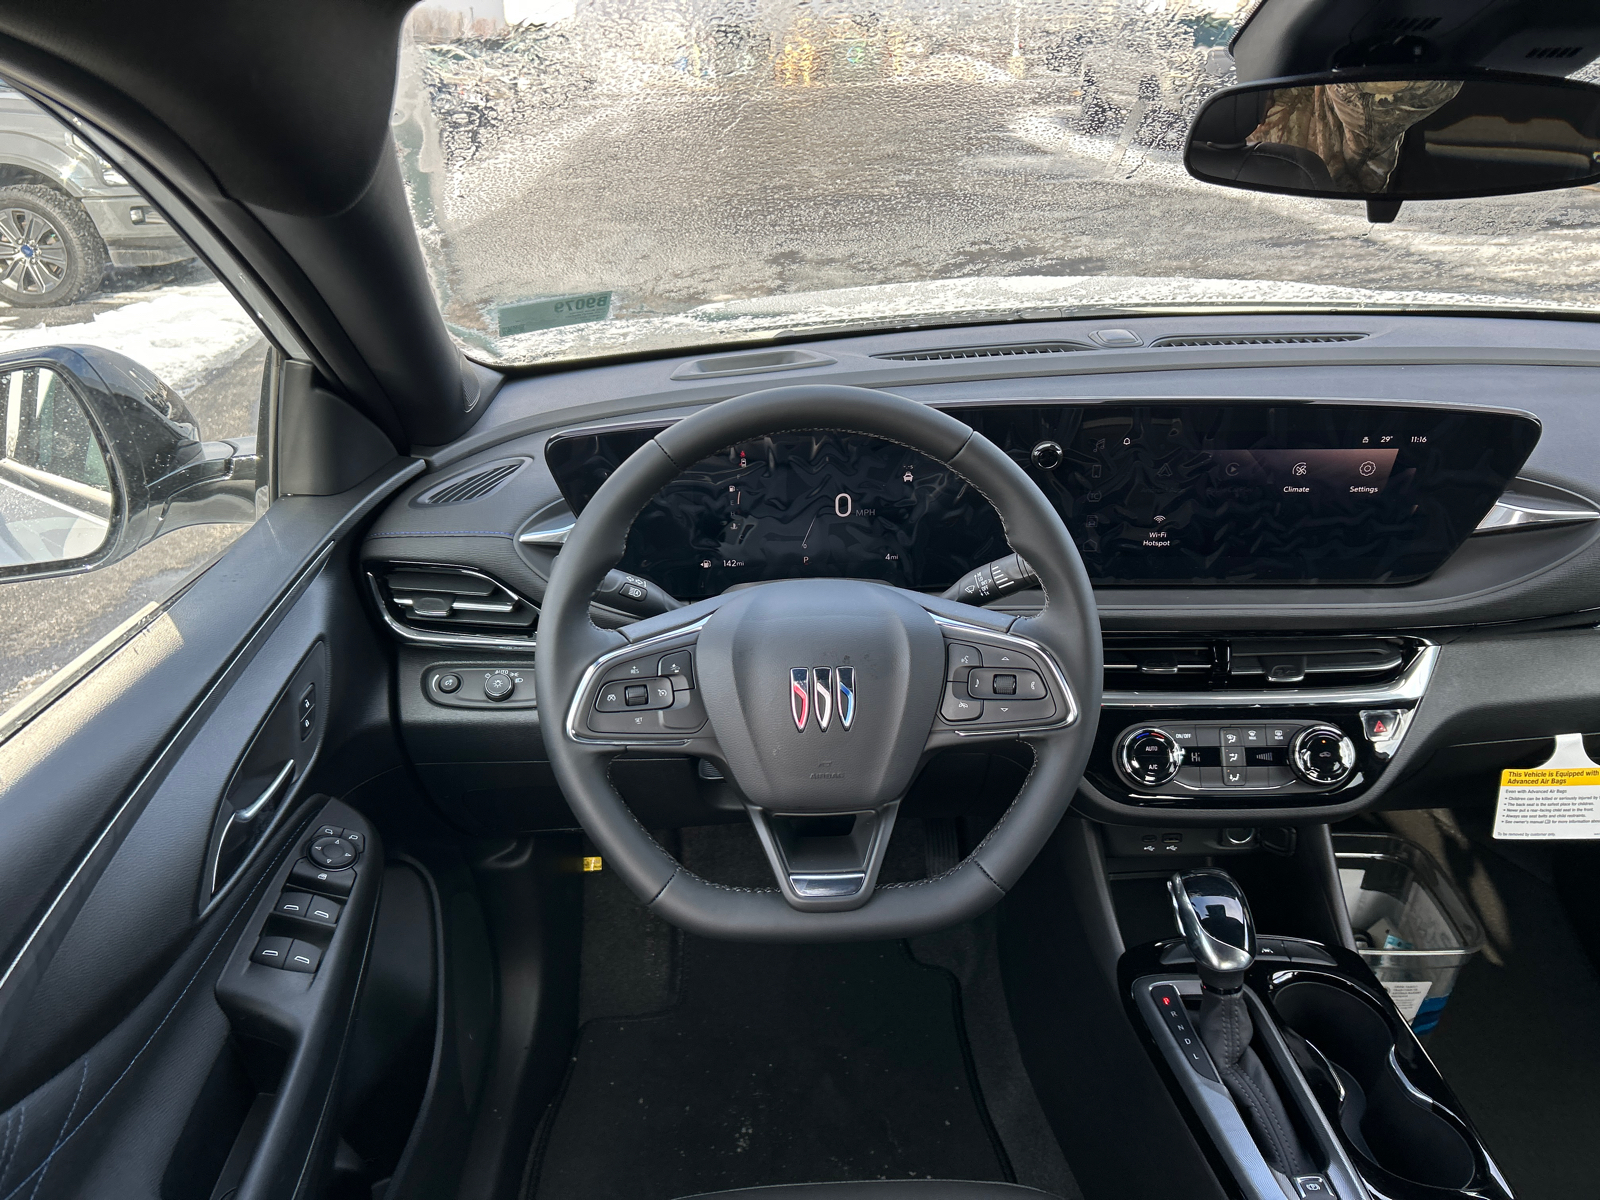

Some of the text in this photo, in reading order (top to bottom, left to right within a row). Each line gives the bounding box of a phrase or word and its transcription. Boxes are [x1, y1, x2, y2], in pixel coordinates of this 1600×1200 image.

[1380, 435, 1393, 443] 29°
[835, 493, 876, 517] 0 MPH
[723, 559, 745, 567] 142mi
[803, 556, 809, 564] P
[1556, 770, 1584, 778] Equipped
